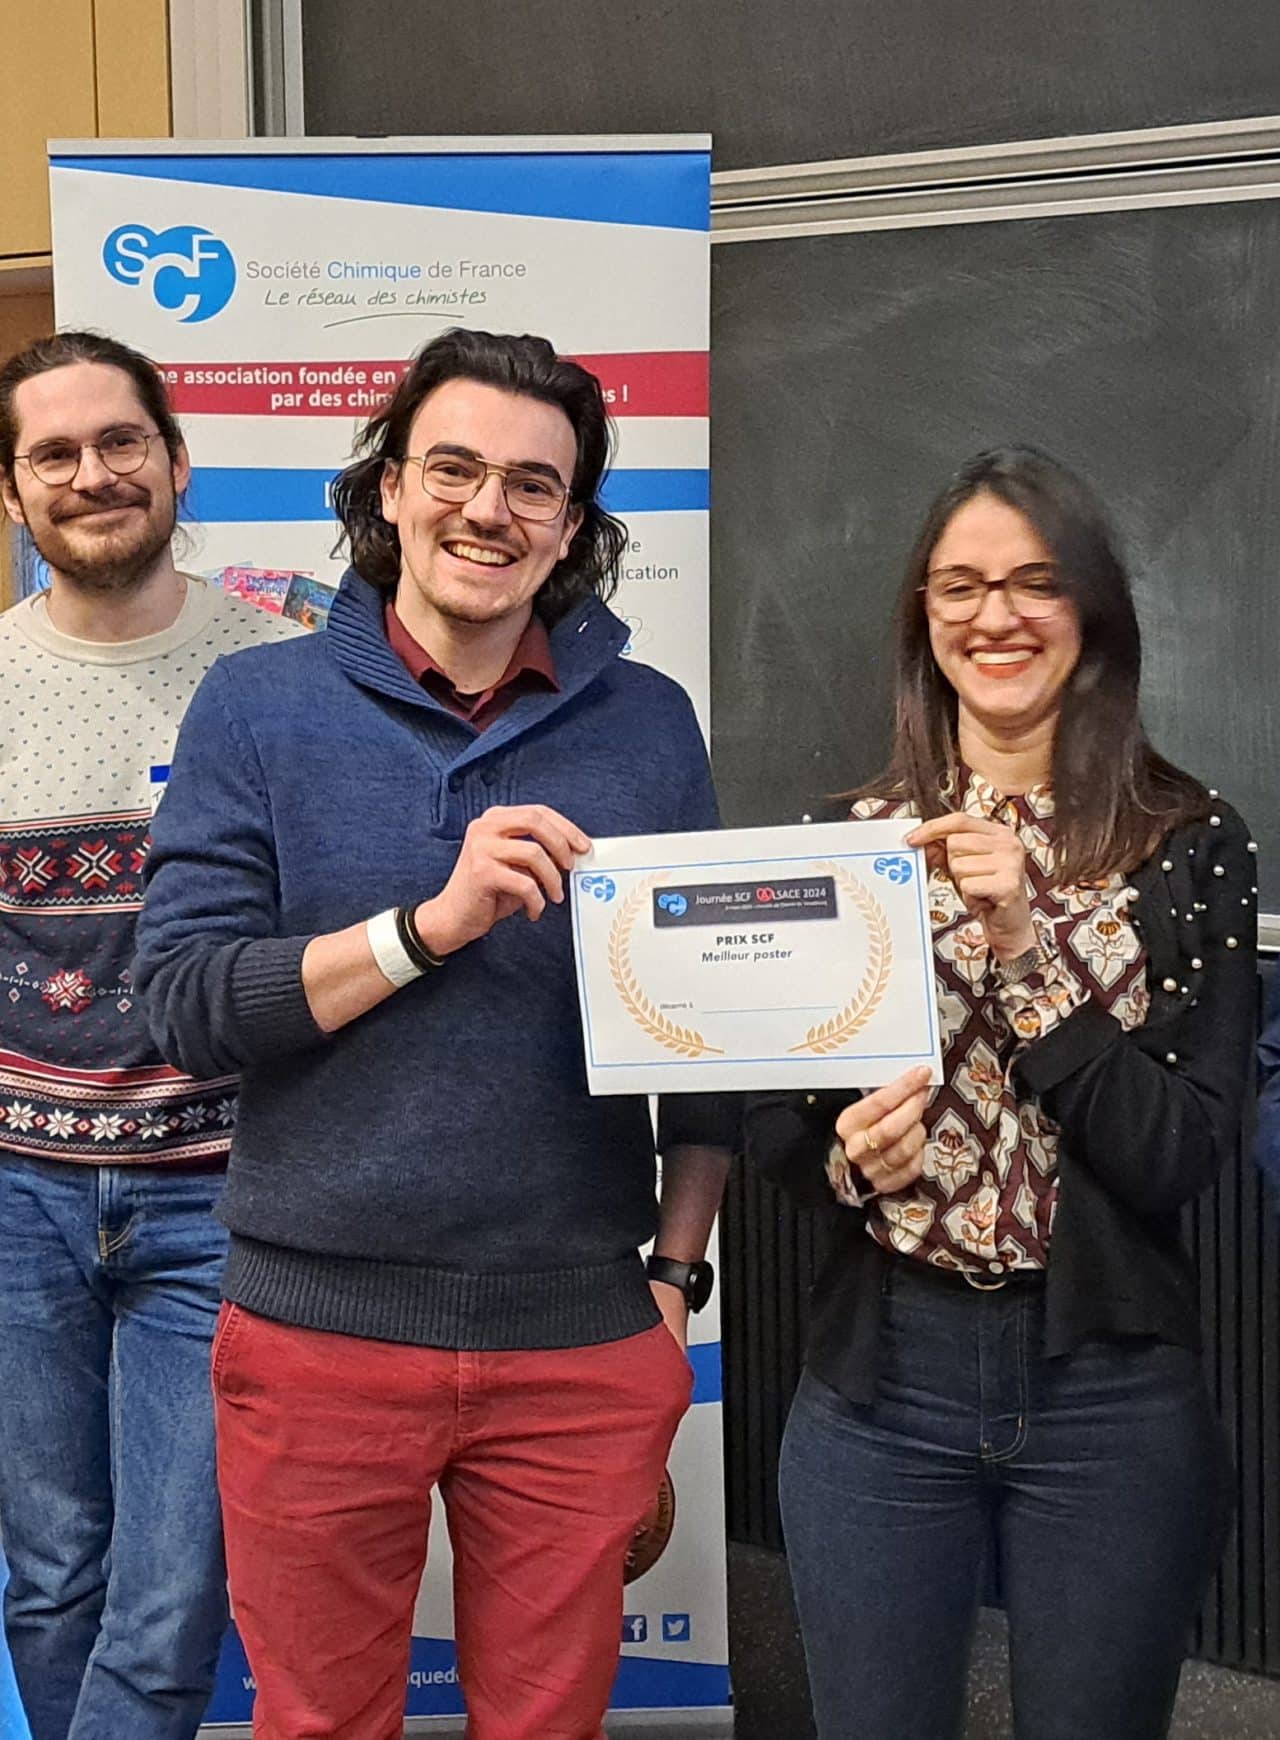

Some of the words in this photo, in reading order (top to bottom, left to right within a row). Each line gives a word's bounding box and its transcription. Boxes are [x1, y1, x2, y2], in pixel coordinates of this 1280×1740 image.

[103, 223, 236, 323] SCF
[246, 259, 321, 280] Société
[327, 261, 421, 283] Chimique
[428, 262, 453, 279] de
[459, 261, 527, 279] France
[264, 289, 290, 306] Le
[296, 287, 357, 307] réseau
[367, 290, 397, 306] des
[405, 287, 488, 307] chimistes
[157, 370, 178, 384] ne
[183, 367, 293, 385] association
[299, 366, 367, 385] fondée
[372, 370, 396, 384] en
[271, 391, 303, 410] par
[308, 388, 342, 407] des
[620, 564, 679, 580] ication
[802, 887, 826, 898] 2024
[716, 935, 747, 946] PRIX
[751, 933, 775, 944] SCF
[702, 951, 750, 963] Meilleur
[753, 949, 793, 962] poster
